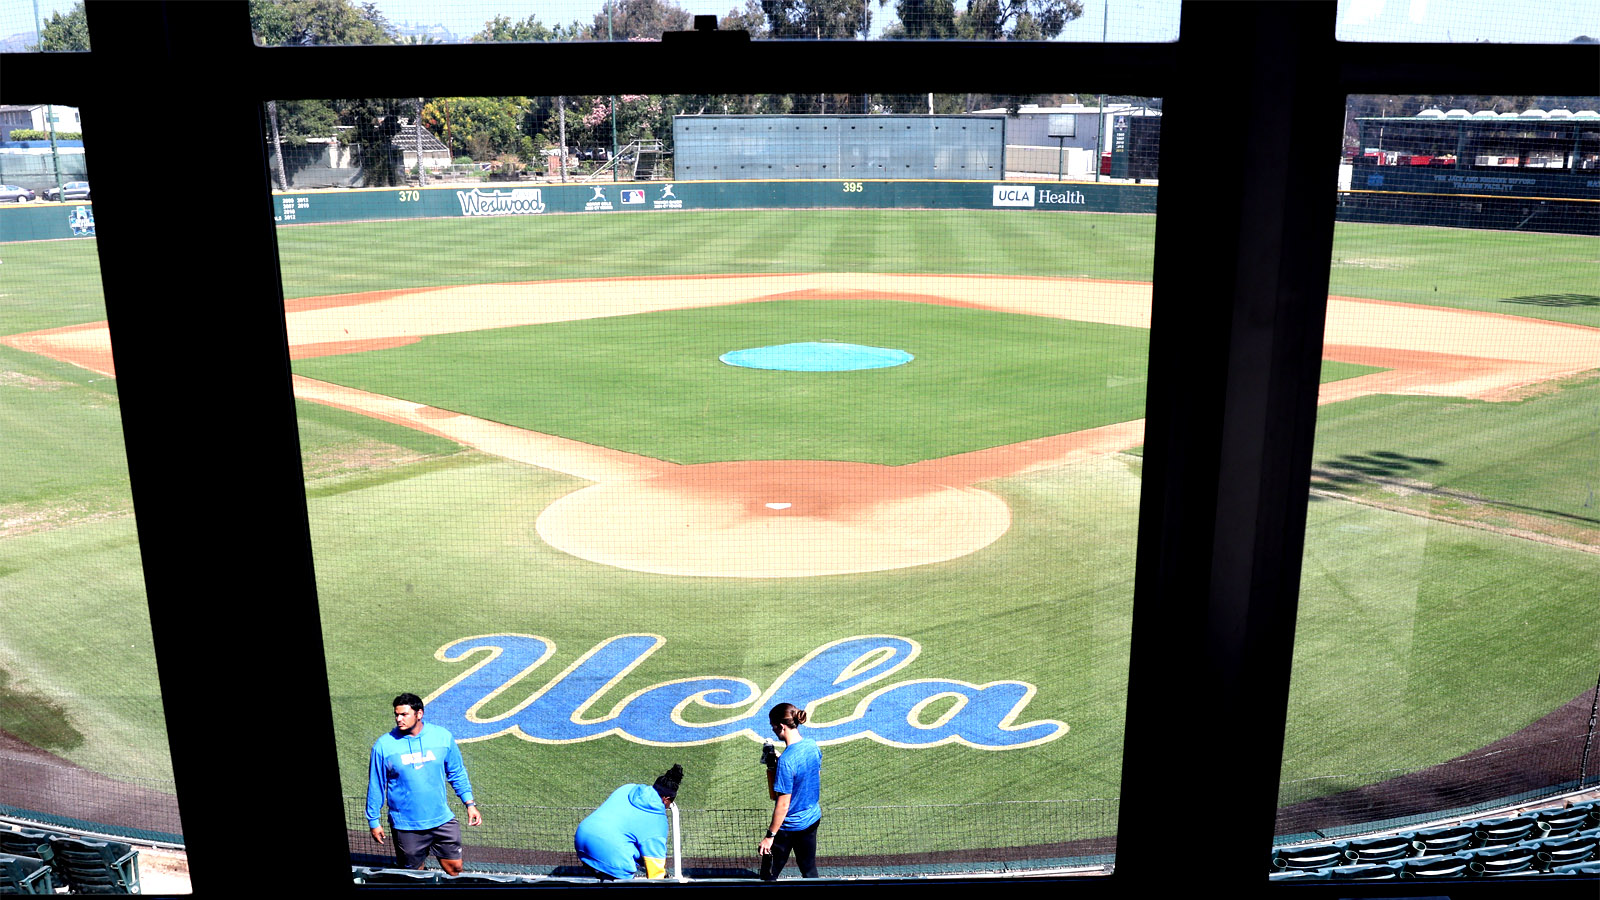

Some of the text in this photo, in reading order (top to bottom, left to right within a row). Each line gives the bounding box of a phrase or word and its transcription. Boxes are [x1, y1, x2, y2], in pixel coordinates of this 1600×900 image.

[842, 182, 863, 192] 395
[399, 190, 420, 202] 370
[457, 188, 545, 215] Westwood
[998, 190, 1085, 204] UCLA Health
